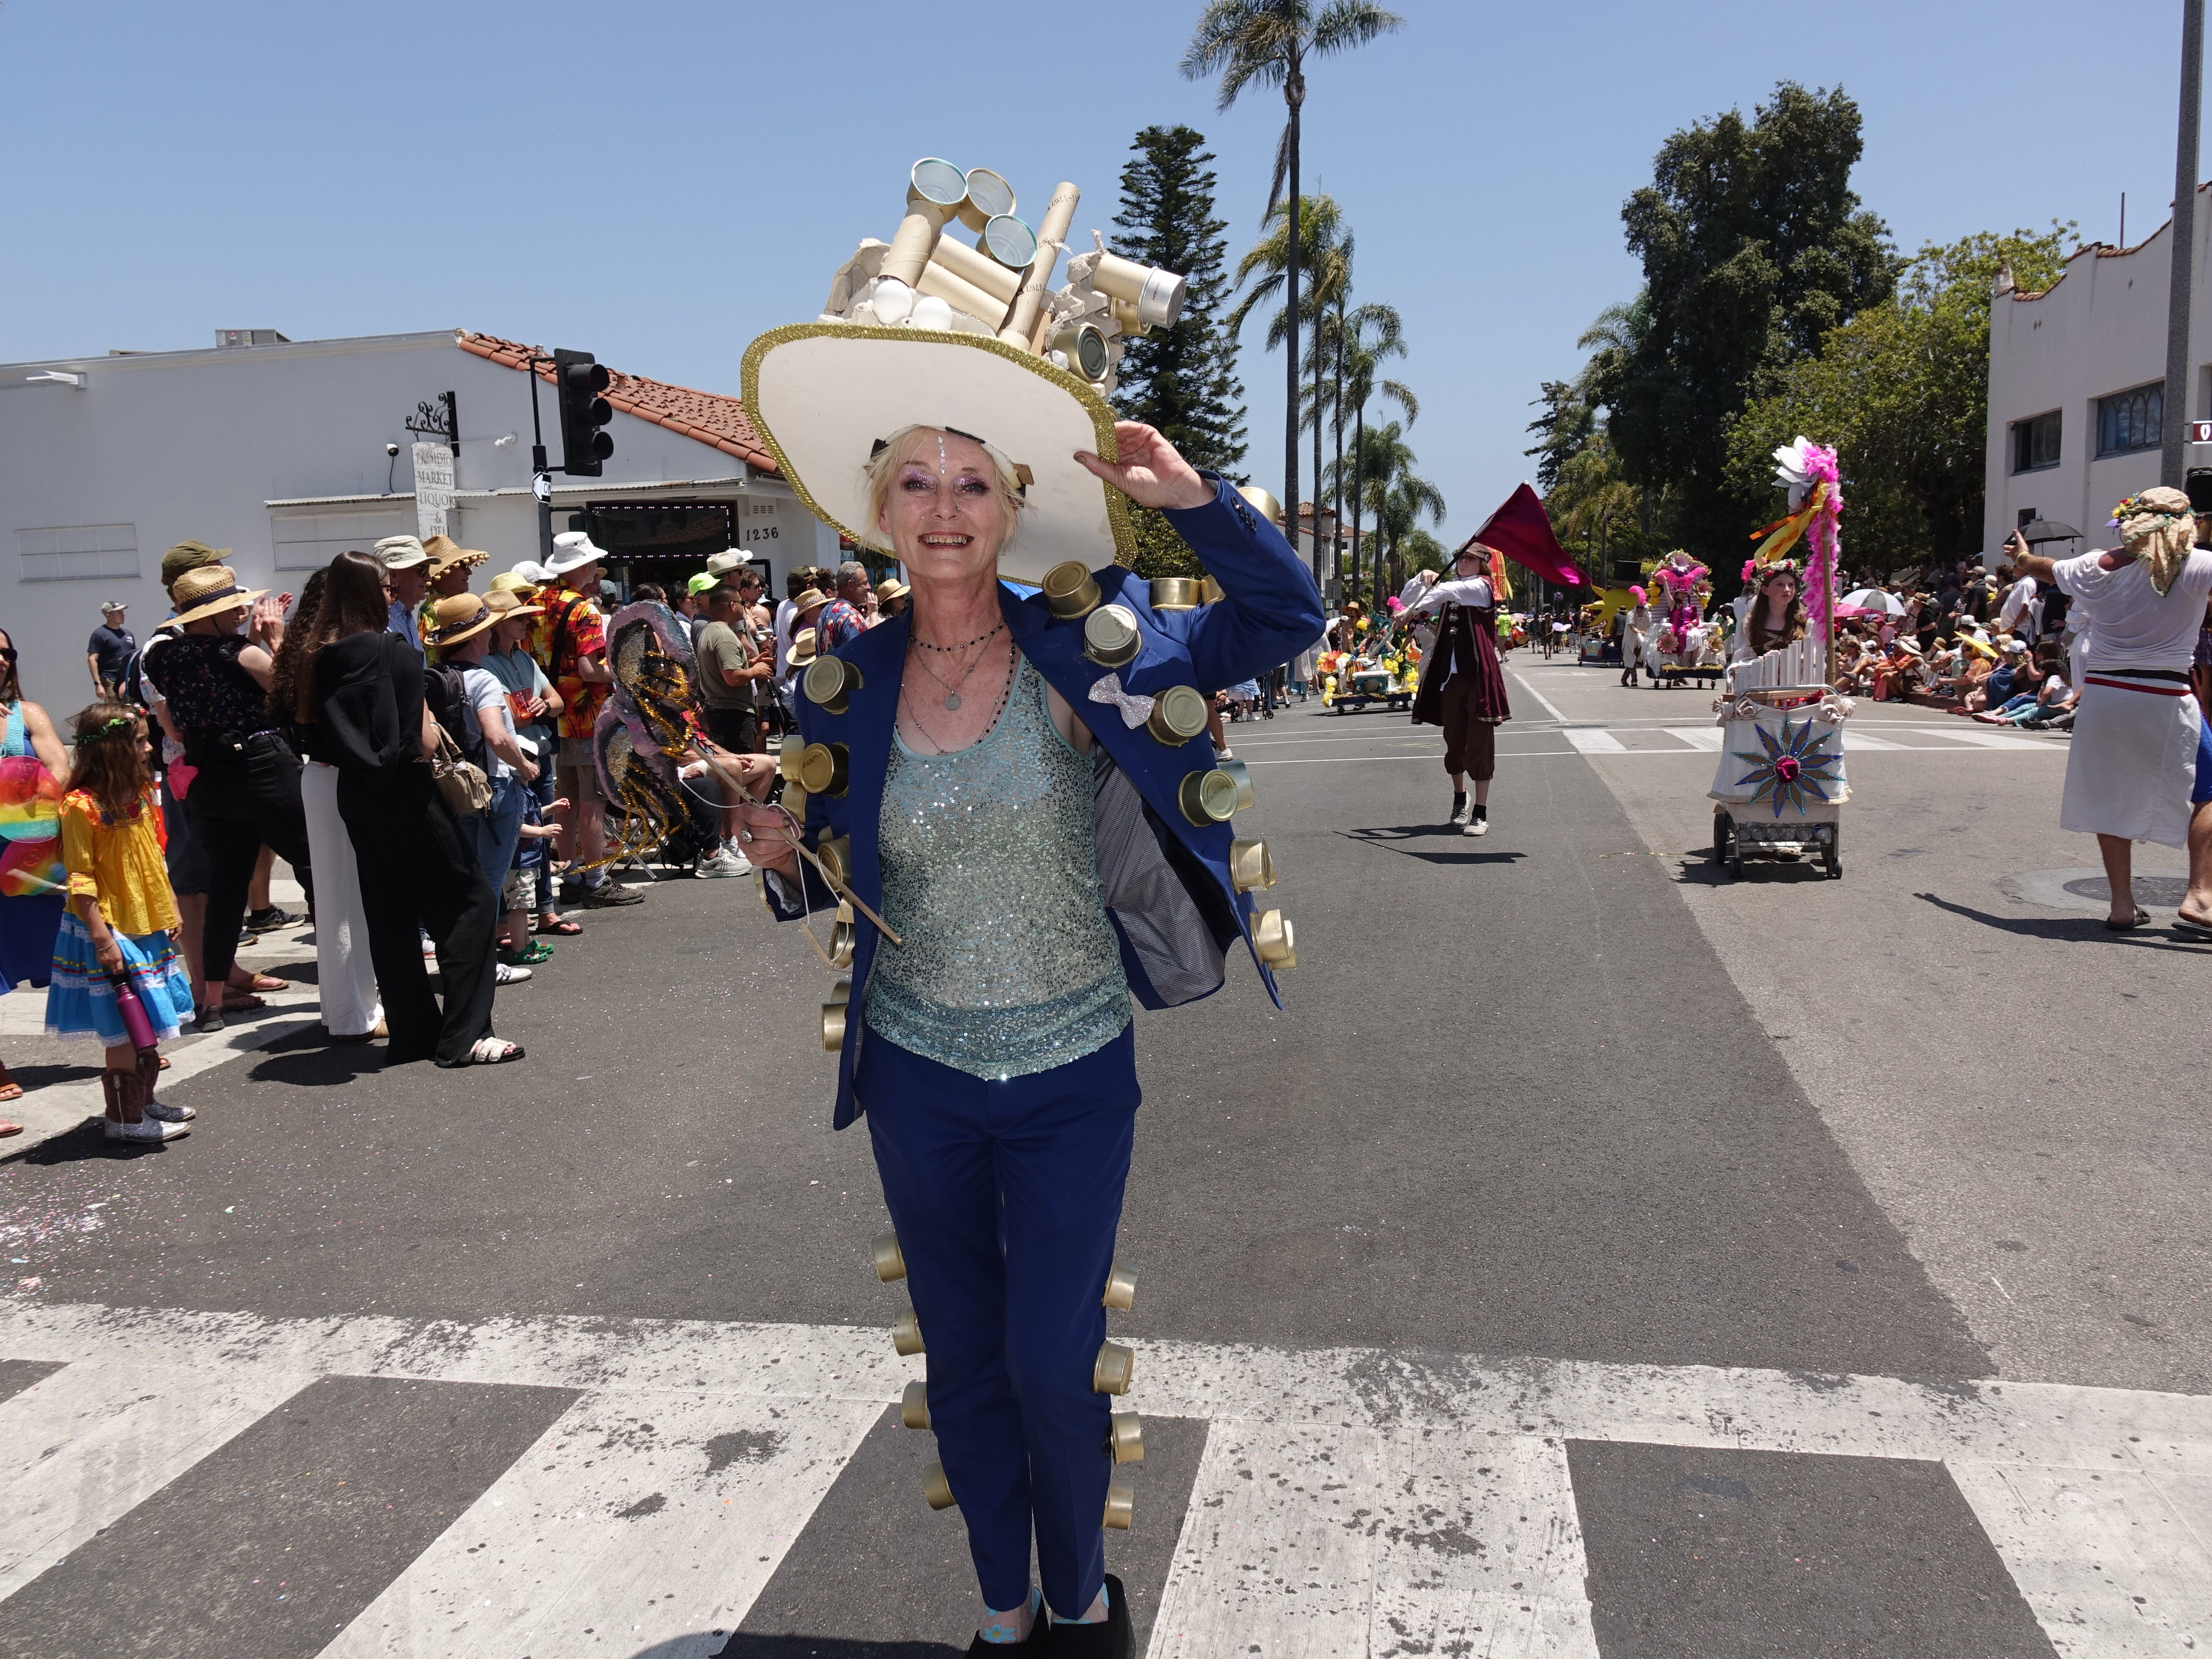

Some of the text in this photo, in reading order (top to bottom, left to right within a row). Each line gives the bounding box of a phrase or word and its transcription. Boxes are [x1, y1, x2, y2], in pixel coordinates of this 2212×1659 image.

[415, 451, 452, 466] PRESIDIO
[417, 471, 452, 485] MARKET
[420, 492, 455, 508] LIQUOR
[436, 512, 443, 523] &
[746, 527, 779, 541] 1236
